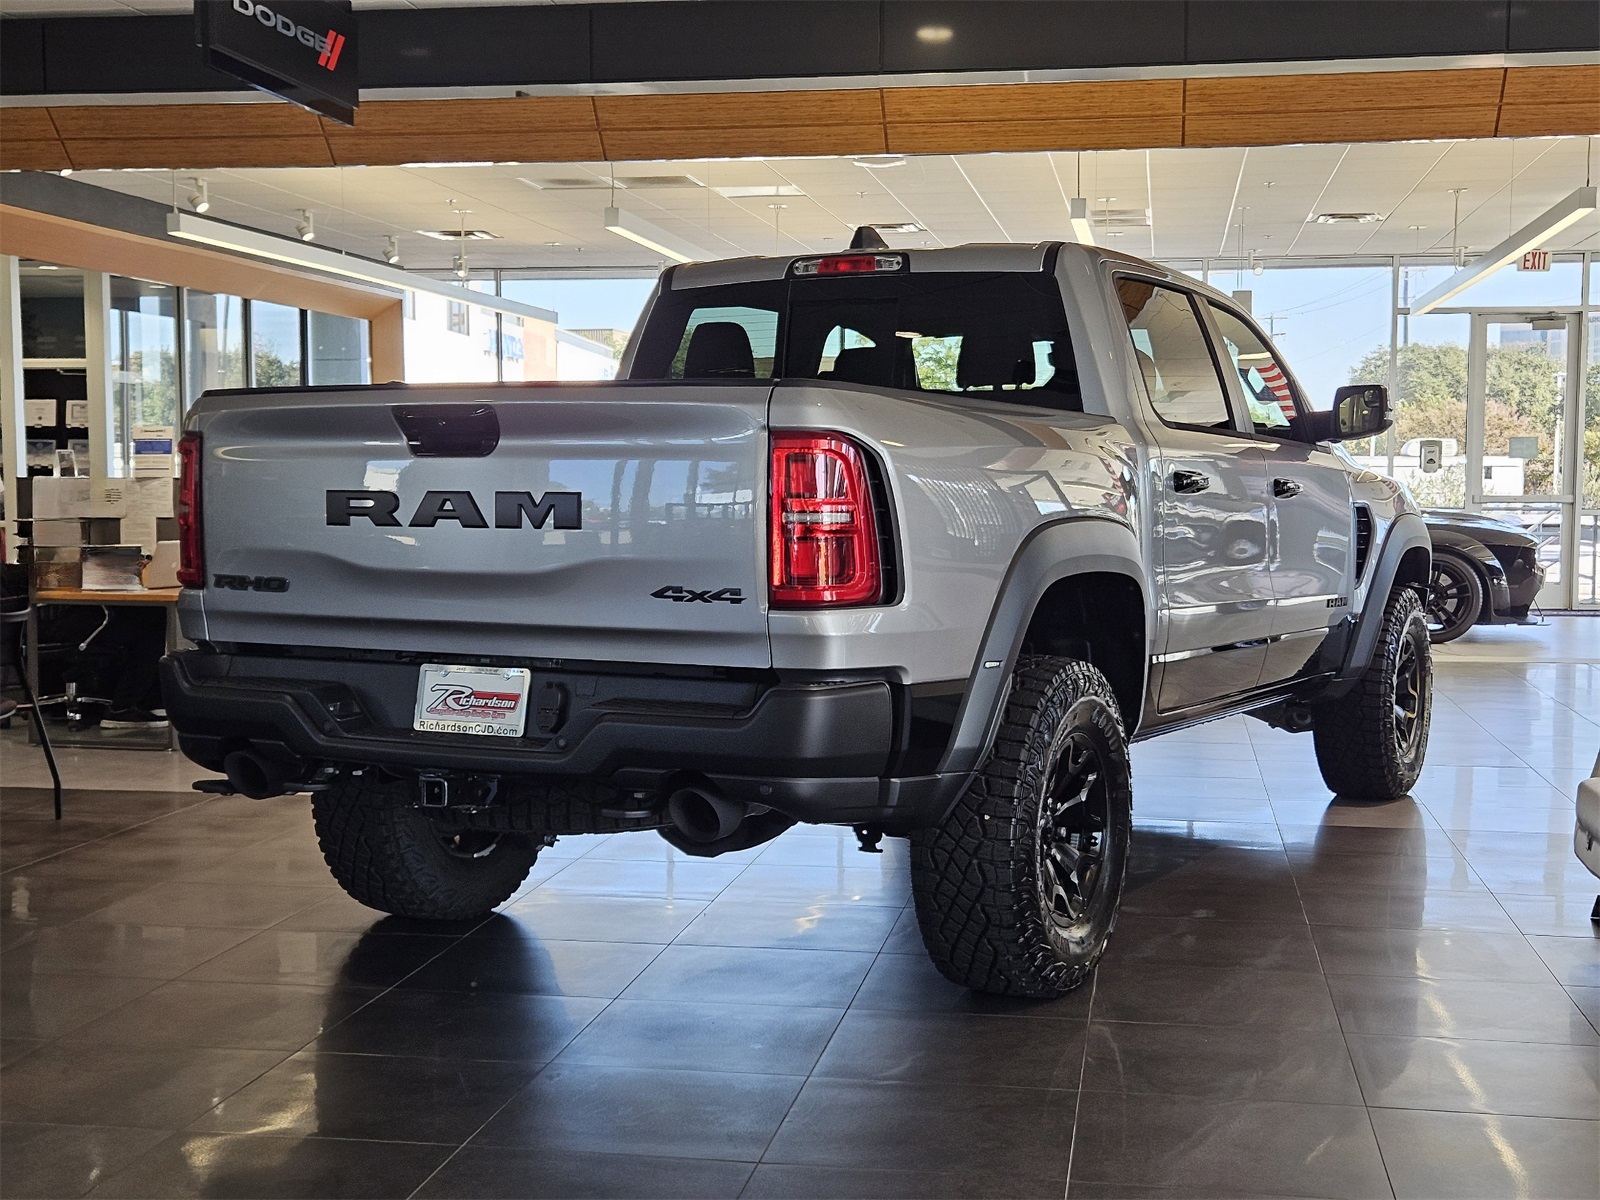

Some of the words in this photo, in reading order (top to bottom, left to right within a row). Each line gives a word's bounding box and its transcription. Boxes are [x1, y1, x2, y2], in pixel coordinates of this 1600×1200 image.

[233, 0, 331, 57] DODGE
[1523, 251, 1548, 270] EXIT
[326, 489, 582, 530] RAM
[213, 574, 290, 593] RHO
[426, 684, 516, 713] Richardson
[419, 720, 518, 736] RichardsonCJD.com
